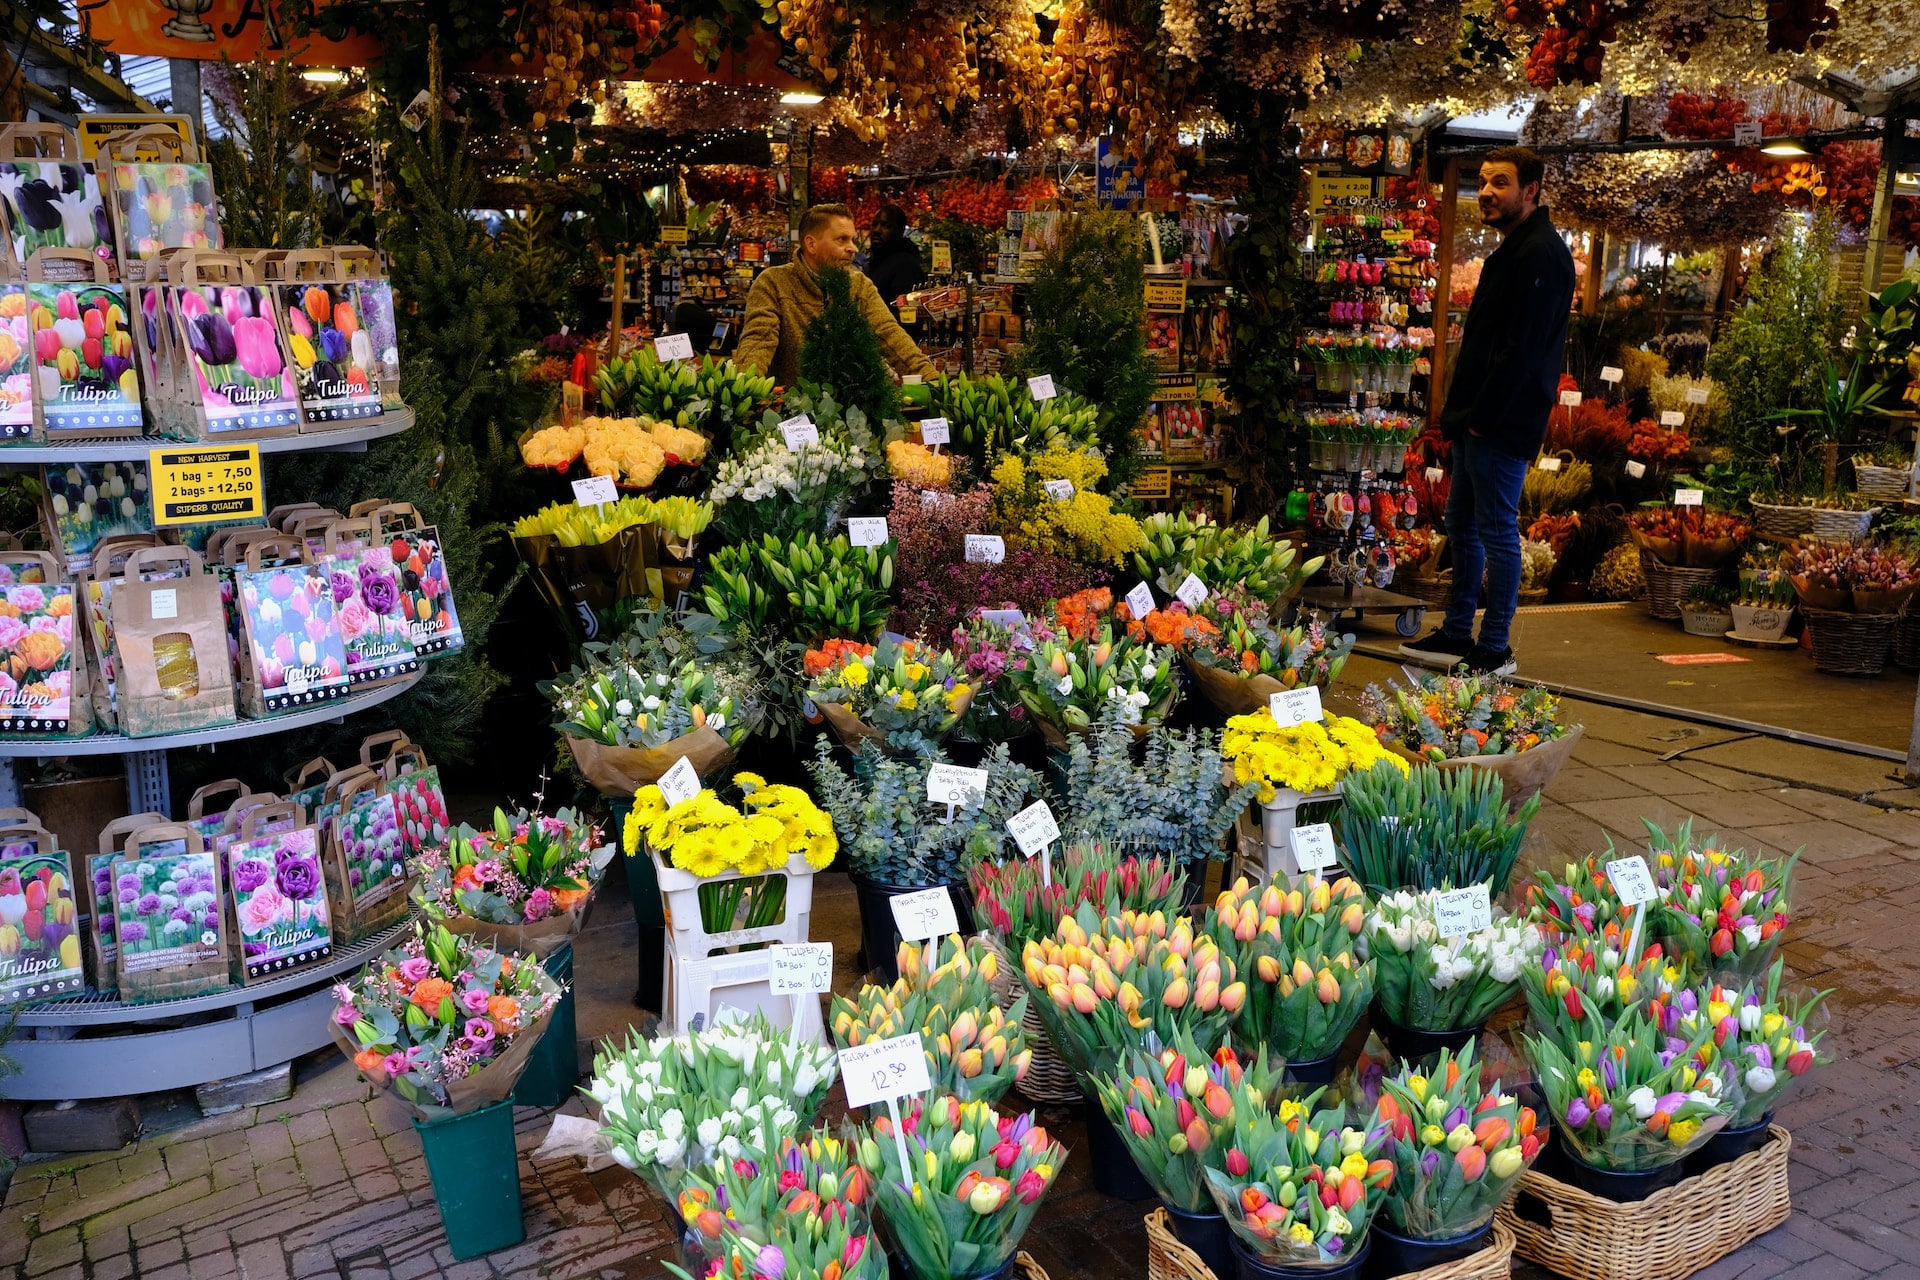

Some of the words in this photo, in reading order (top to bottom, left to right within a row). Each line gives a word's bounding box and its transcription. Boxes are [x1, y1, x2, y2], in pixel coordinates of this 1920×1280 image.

[1105, 177, 1138, 186] CARA
[59, 384, 121, 406] Tulipa
[223, 385, 278, 407] Tulipa
[317, 378, 366, 398] Tulipa
[177, 456, 195, 464] NEW
[198, 453, 231, 463] HARVEST
[170, 472, 175, 481] 1
[182, 472, 201, 482] bag
[224, 467, 252, 480] 7,50
[171, 487, 177, 496] 2
[181, 486, 205, 497] bags
[217, 481, 253, 494] 12,50
[176, 503, 208, 514] SUPERB
[211, 501, 244, 511] QUALITY
[676, 571, 690, 579] THE
[406, 617, 446, 637] Tulipa
[1695, 615, 1720, 623] HOME
[355, 642, 400, 660] Tulipa
[280, 664, 332, 684] Tulipa
[0, 687, 52, 710] Tulipa
[263, 928, 314, 949] Tulipa
[0, 957, 61, 977] Tulipa
